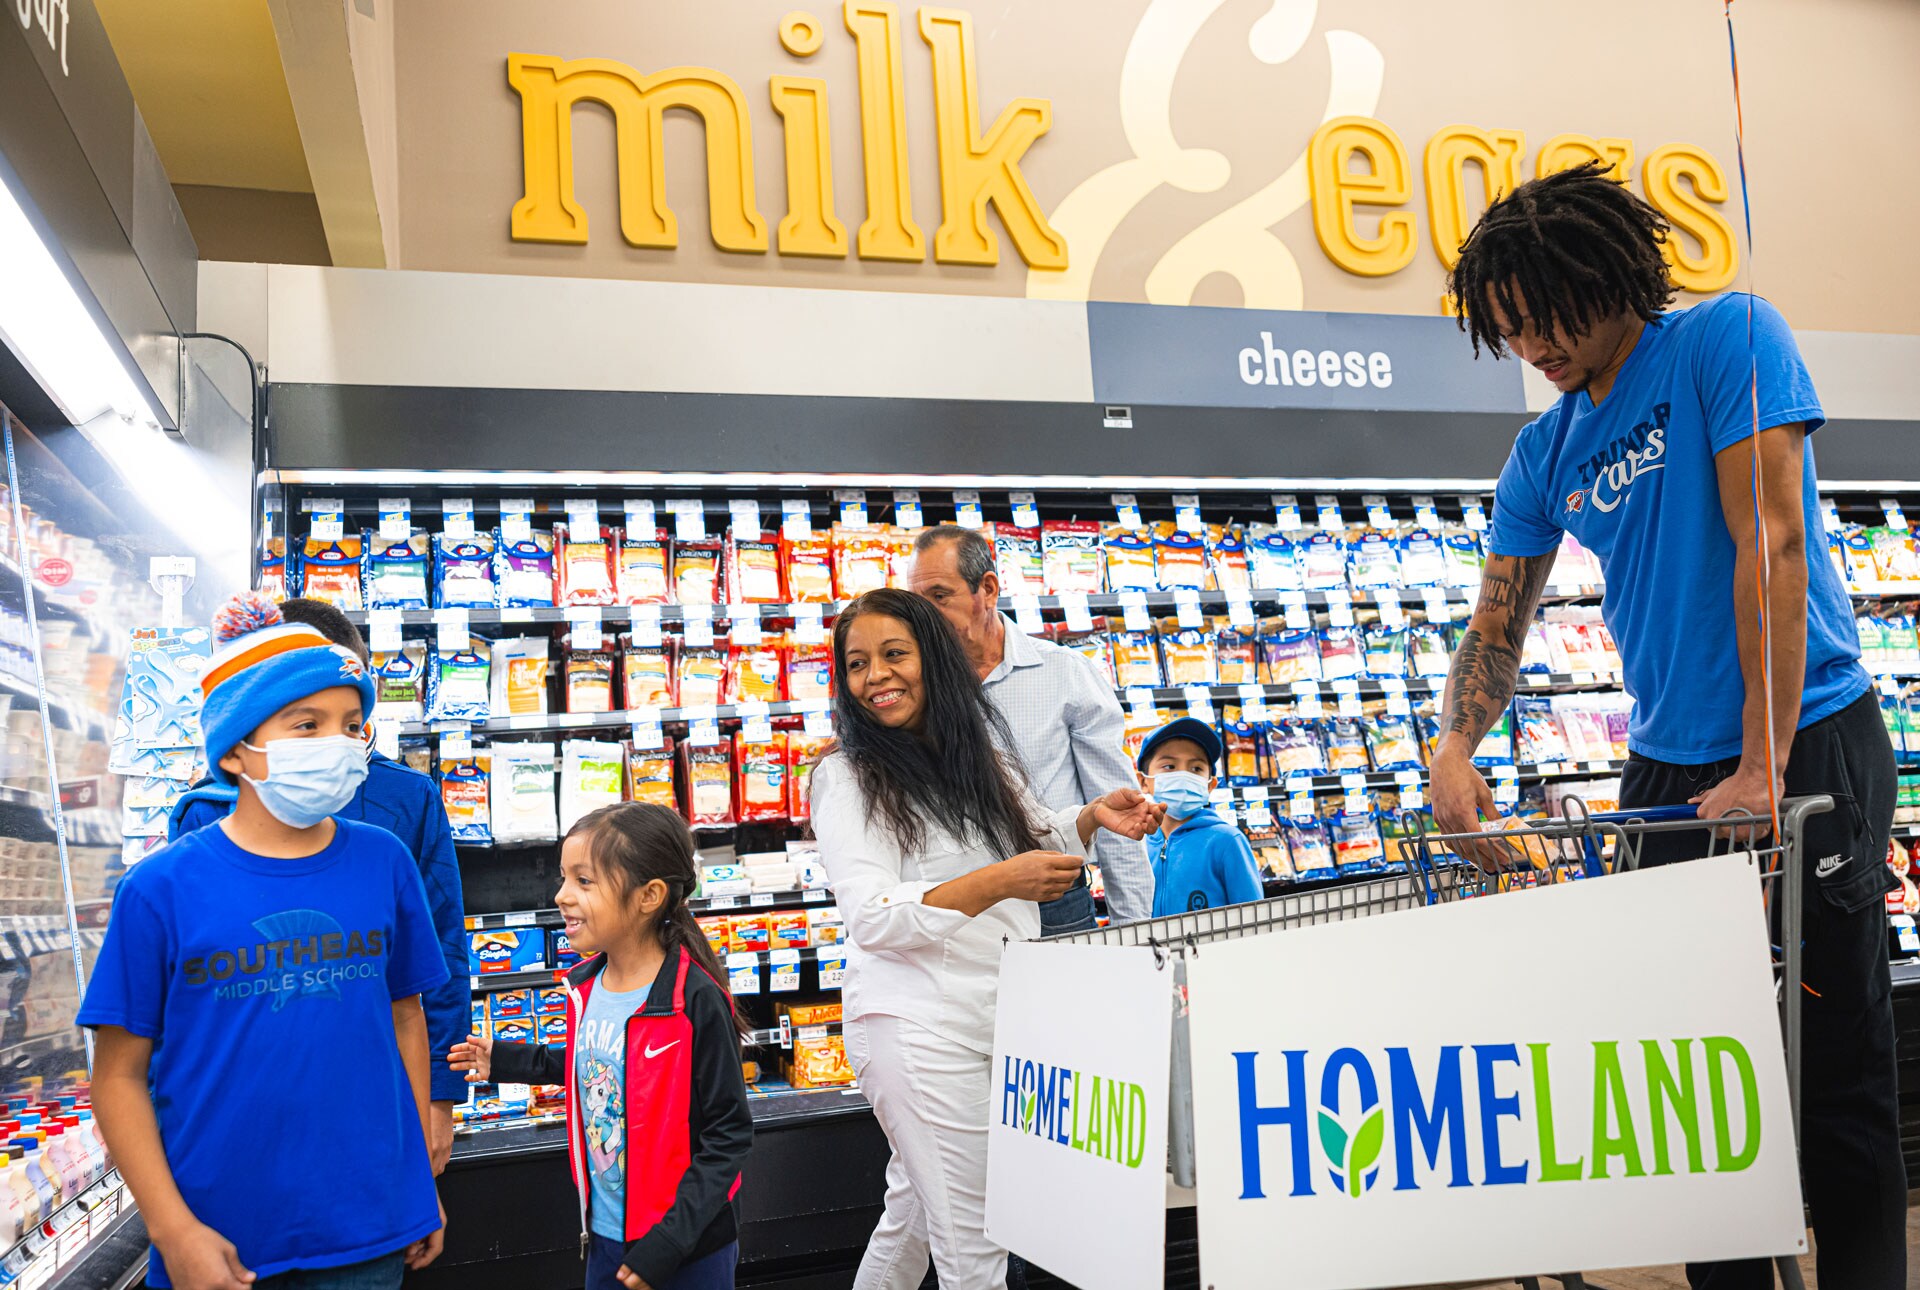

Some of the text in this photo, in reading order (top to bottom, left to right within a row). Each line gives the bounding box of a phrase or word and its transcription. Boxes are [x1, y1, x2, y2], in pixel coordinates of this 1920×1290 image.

[506, 0, 1068, 270] milk
[1238, 331, 1392, 388] cheese
[1577, 402, 1671, 485] THUNDR
[623, 540, 661, 549] SARGENTO
[791, 651, 828, 662] Borden
[1819, 854, 1842, 870] NIKE
[183, 930, 388, 985] SOUTHEAS
[480, 948, 511, 959] Singles
[215, 962, 379, 1001] MIDDLE SCHOOL
[744, 979, 757, 987] 2.99
[784, 976, 797, 984] 2.99
[546, 1024, 567, 1032] Singl
[1002, 1055, 1146, 1168] HOMELAND
[1231, 1036, 1761, 1199] HOMELAND
